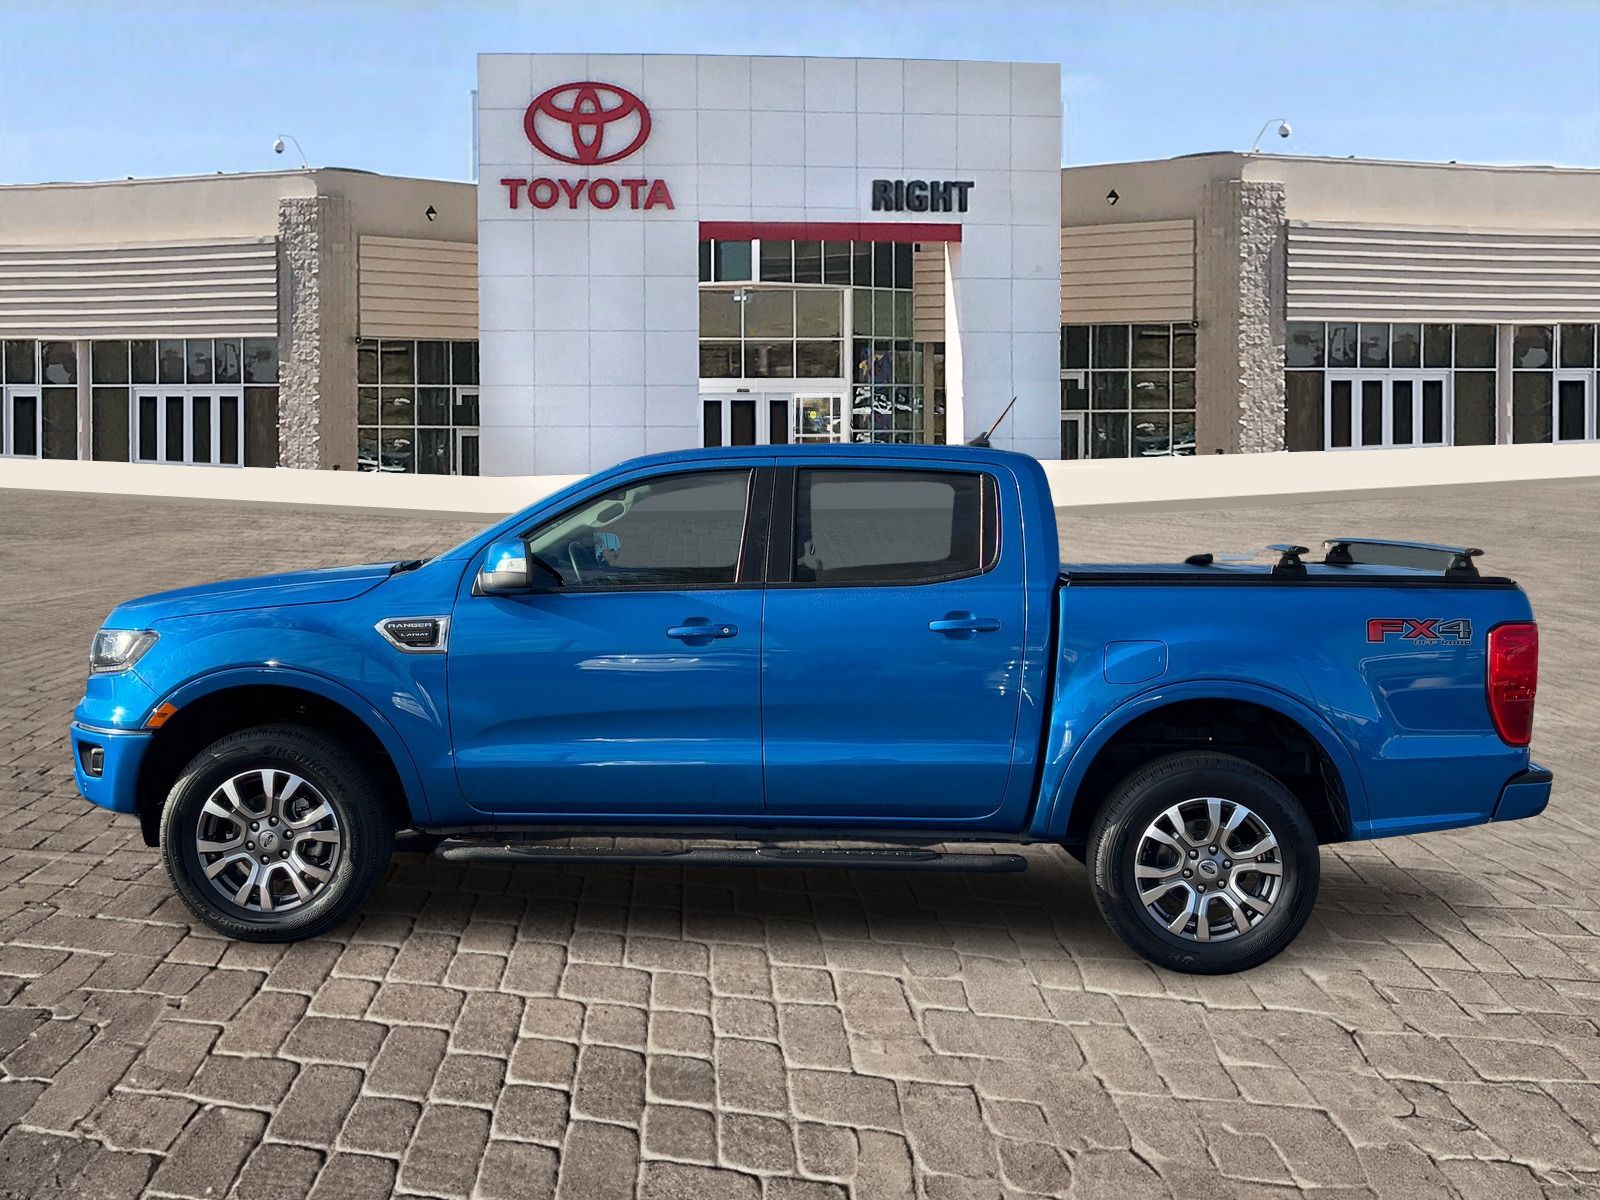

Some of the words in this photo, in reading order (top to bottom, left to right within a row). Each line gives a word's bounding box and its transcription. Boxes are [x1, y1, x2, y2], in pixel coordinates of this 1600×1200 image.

[500, 177, 676, 210] TOYOTA
[872, 179, 975, 212] RIGHT
[1366, 618, 1472, 643] FX4
